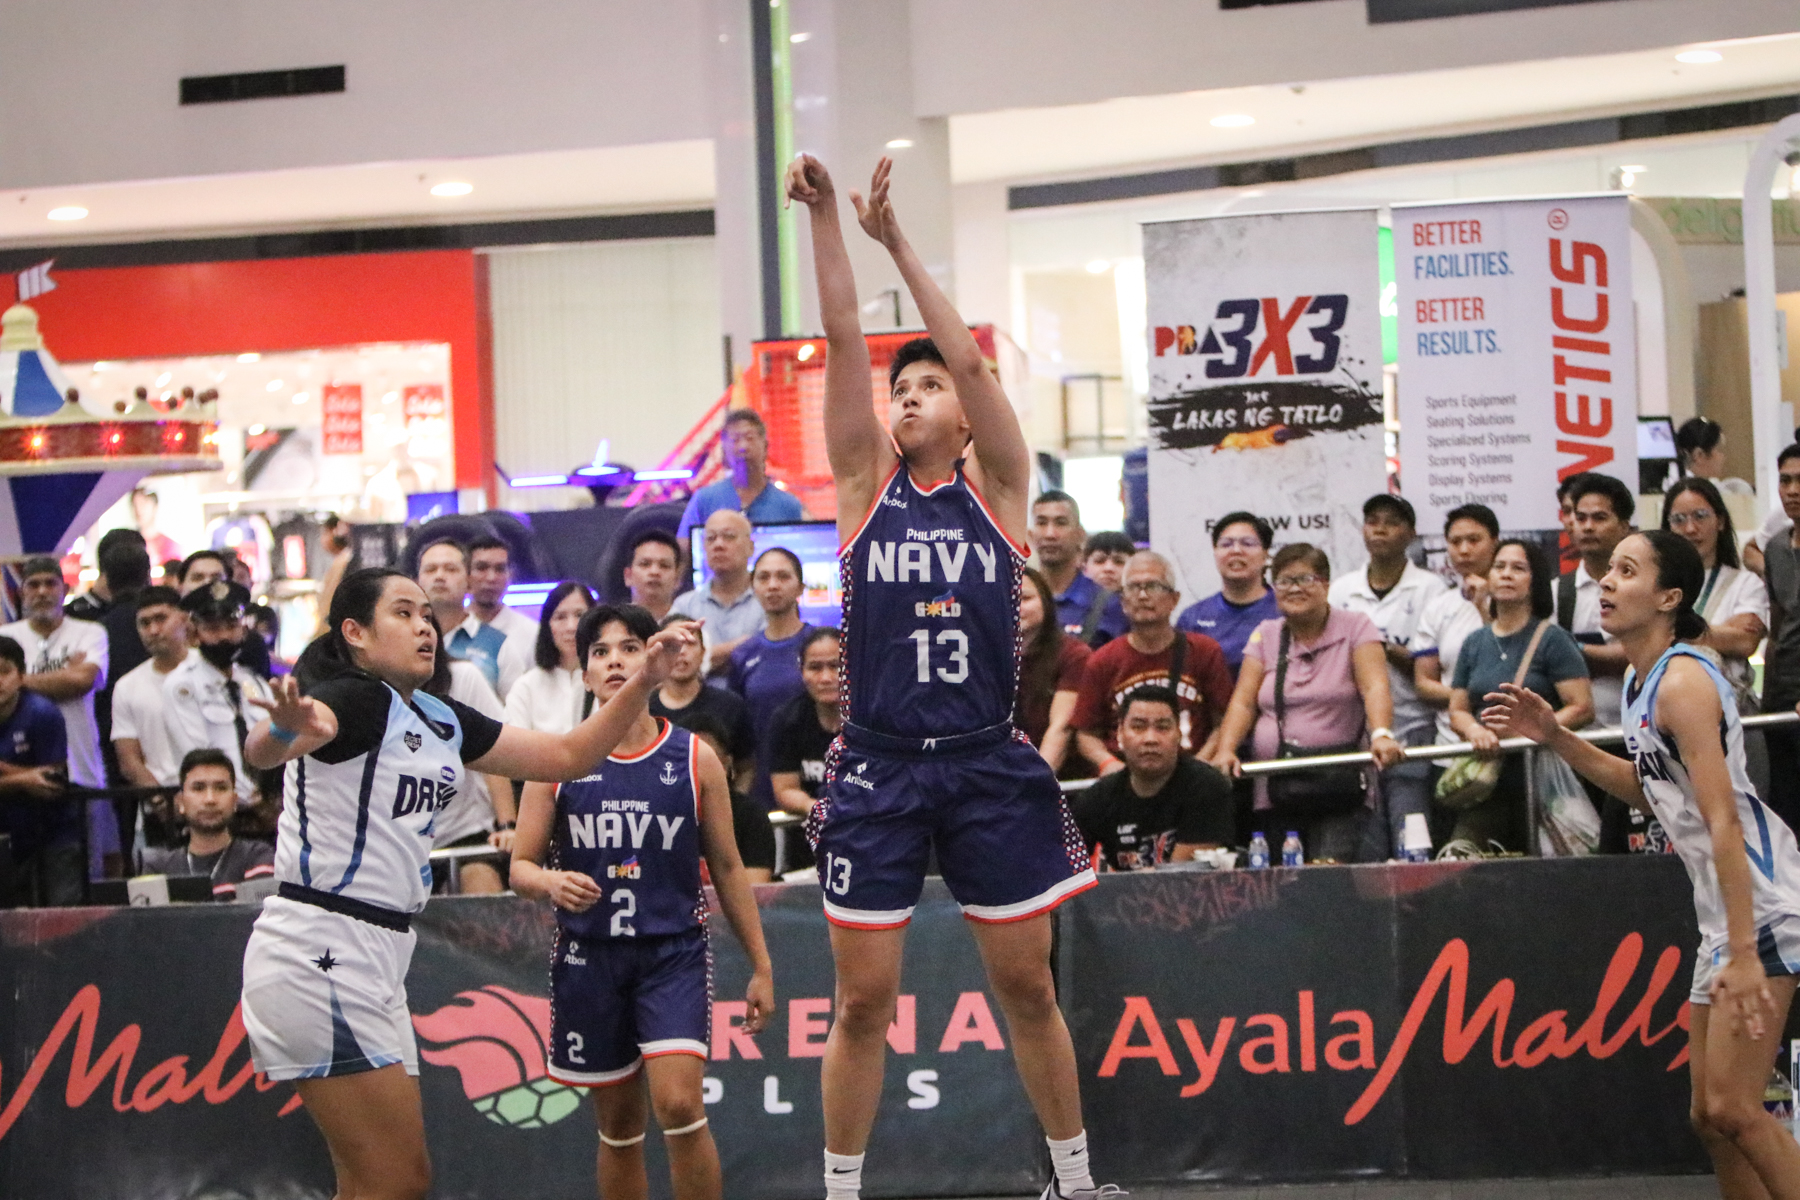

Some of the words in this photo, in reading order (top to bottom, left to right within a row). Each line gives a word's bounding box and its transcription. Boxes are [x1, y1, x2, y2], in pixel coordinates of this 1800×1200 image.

[1413, 219, 1482, 246] BETTER
[1415, 251, 1514, 279] FACILITIES.
[1416, 297, 1484, 323] BETTER
[1205, 294, 1349, 379] 3X3
[1417, 329, 1502, 356] RESULTS.
[1425, 396, 1459, 410] Sports
[1461, 394, 1517, 408] Equipment
[1172, 408, 1237, 430] LAKAS
[1244, 405, 1273, 427] NG
[1279, 403, 1343, 425] TATLO
[1426, 415, 1465, 429] Seating
[1467, 413, 1515, 427] Solutions
[1427, 435, 1485, 449] Specialized
[1488, 432, 1531, 447] Systems
[1428, 454, 1466, 467] Scoring
[1468, 452, 1513, 467] Systems
[1428, 473, 1464, 487] Display
[1467, 472, 1512, 487] Systems
[1429, 493, 1462, 507] Sports
[906, 528, 964, 541] PHILIPPINE
[1299, 514, 1330, 529] US!
[867, 540, 996, 583] NAVY
[908, 629, 969, 684] 13
[601, 800, 650, 813] PHILIPPINE
[568, 812, 684, 851] NAVY
[825, 851, 852, 896] 13
[610, 888, 636, 937] 2
[566, 1030, 586, 1065] 2
[702, 1069, 940, 1114] PLS
